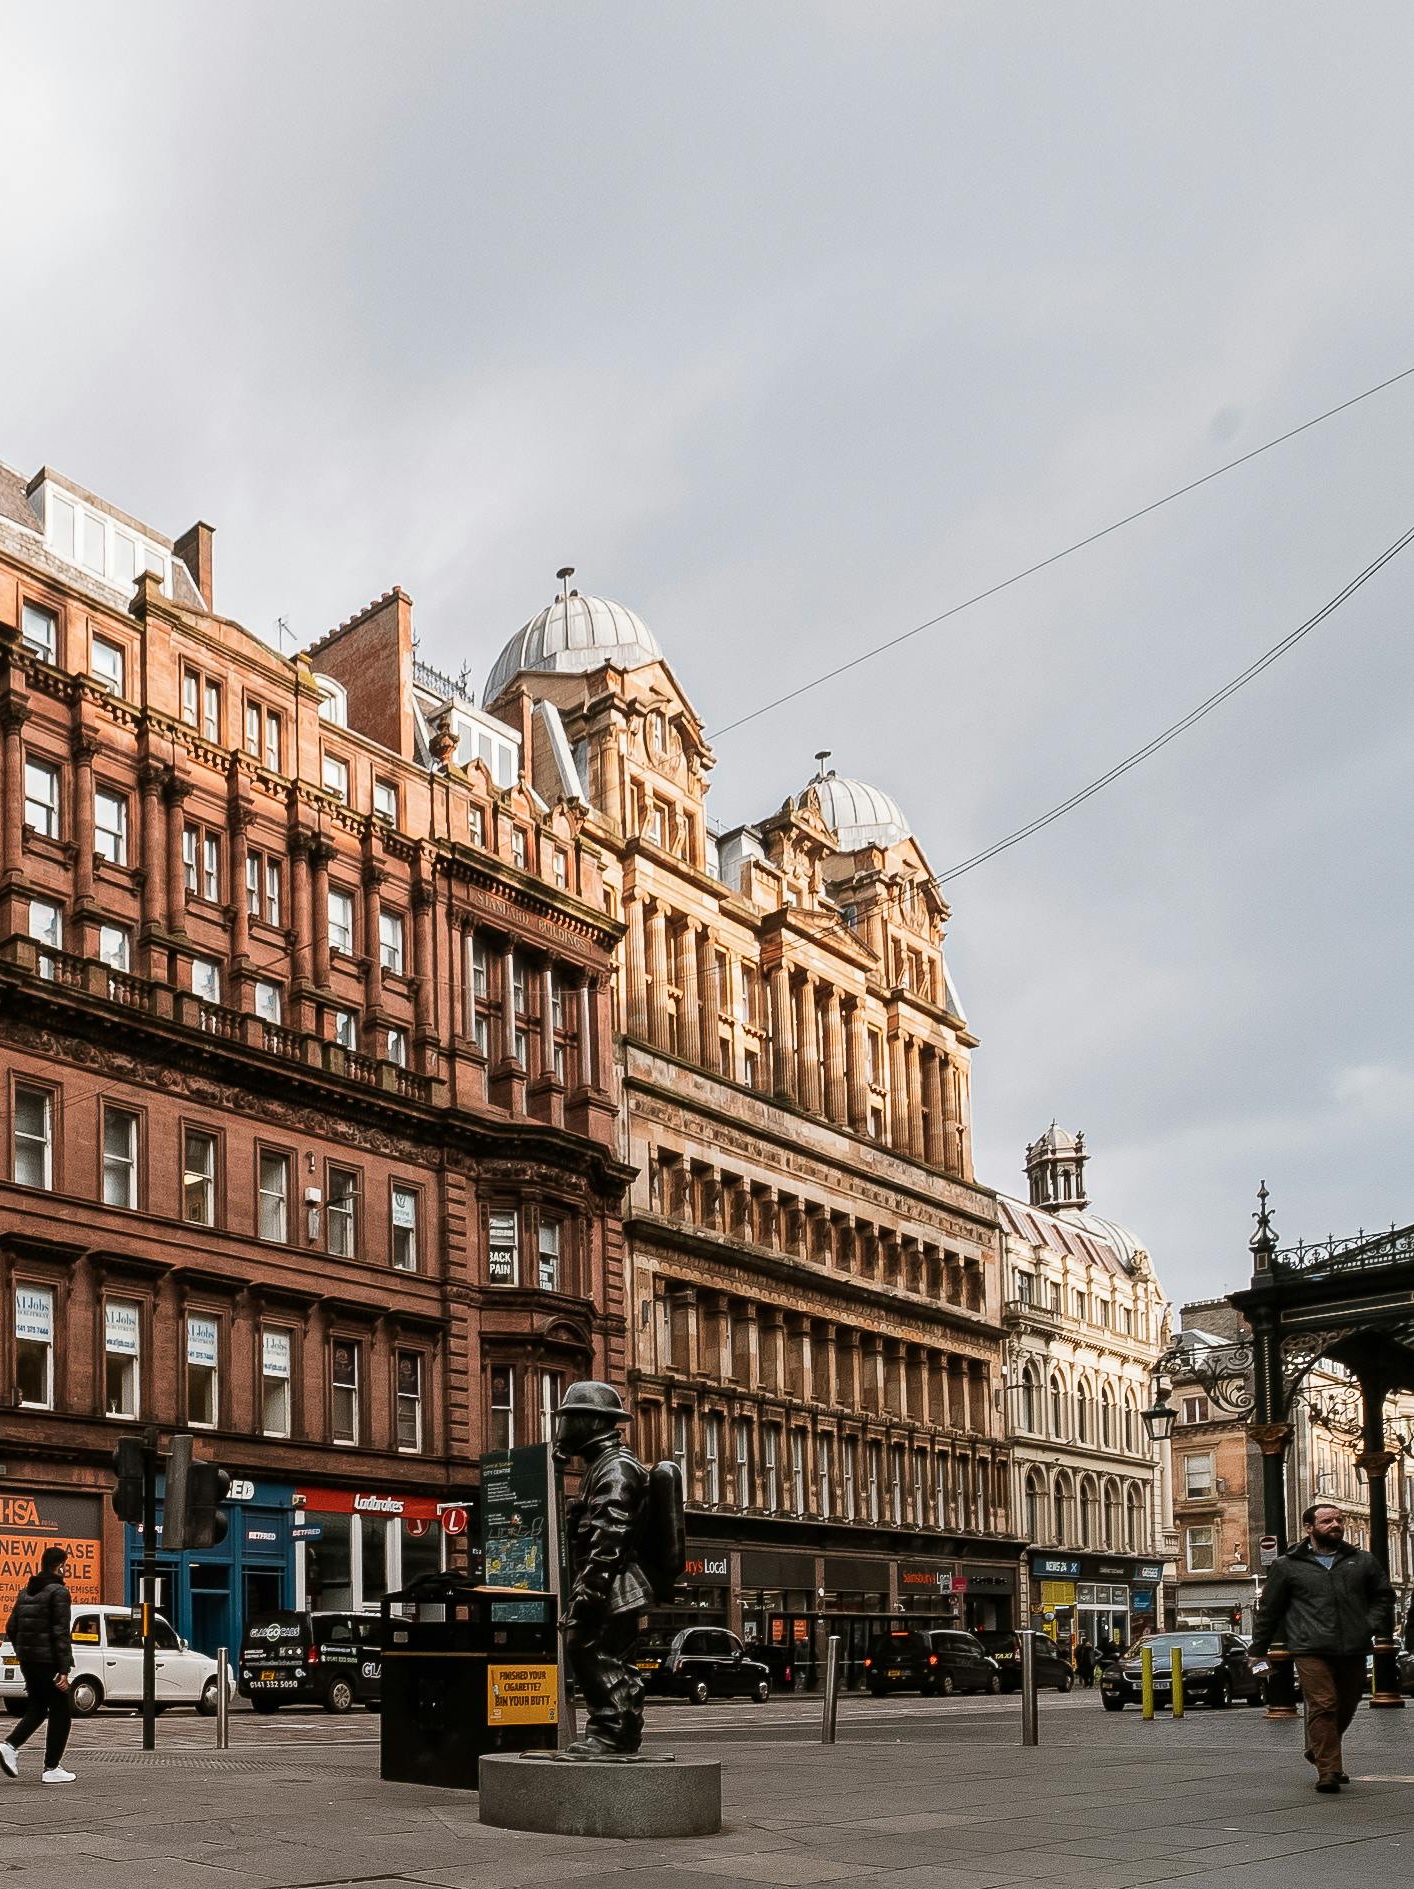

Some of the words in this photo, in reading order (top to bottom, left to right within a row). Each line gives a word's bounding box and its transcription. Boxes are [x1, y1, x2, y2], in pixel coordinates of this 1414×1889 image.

[477, 892, 530, 924] STANDARD
[538, 918, 587, 952] BUILDINGS
[489, 1251, 512, 1263] BACK
[489, 1263, 511, 1275] PAIN
[27, 1297, 49, 1312] Jobs
[116, 1311, 136, 1326] Jobs
[196, 1325, 215, 1339] Jobs
[354, 1493, 405, 1513] Ladbrokes
[248, 1530, 277, 1541] BETFRED
[292, 1528, 321, 1537] BETFRED
[704, 1558, 727, 1575] Local
[994, 1652, 1013, 1660] TAXI
[499, 1671, 529, 1681] FINISHED
[529, 1671, 546, 1680] YOUR
[249, 1681, 265, 1689] 0141
[504, 1682, 542, 1692] CIGARETTE?
[495, 1695, 509, 1707] BIN
[509, 1695, 530, 1707] YOUR
[530, 1695, 551, 1706] BUTT
